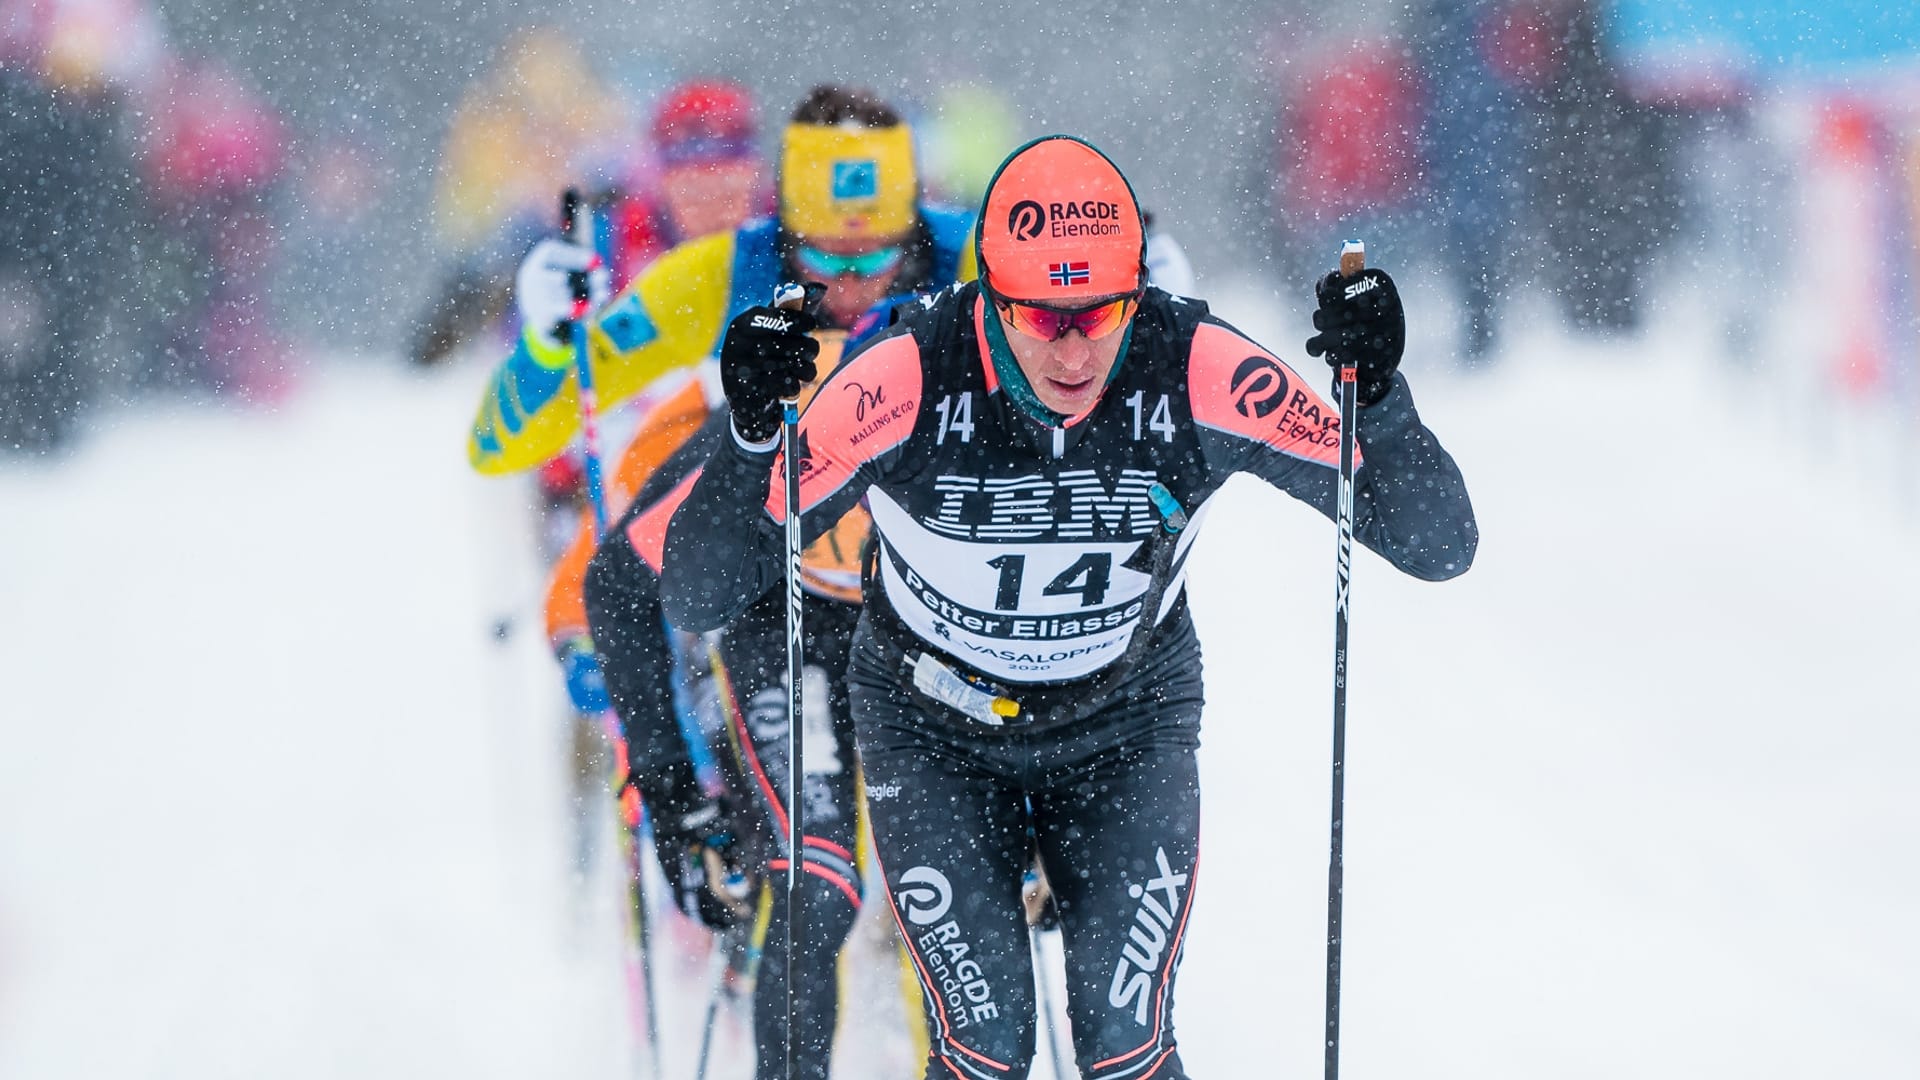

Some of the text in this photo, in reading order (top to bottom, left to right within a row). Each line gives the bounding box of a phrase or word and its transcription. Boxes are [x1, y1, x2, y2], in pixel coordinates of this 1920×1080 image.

[1050, 201, 1119, 220] RAGDE
[1051, 220, 1121, 238] Eiendom
[849, 413, 891, 447] MALLING
[900, 400, 914, 415] CO
[936, 392, 974, 446] 14
[1126, 390, 1176, 443] 14
[923, 469, 1160, 538] IBM
[905, 567, 1142, 637] Petter Eliasse
[986, 552, 1112, 611] 14
[919, 930, 969, 1029] Eiendom
[934, 920, 999, 1023] RAGDE
